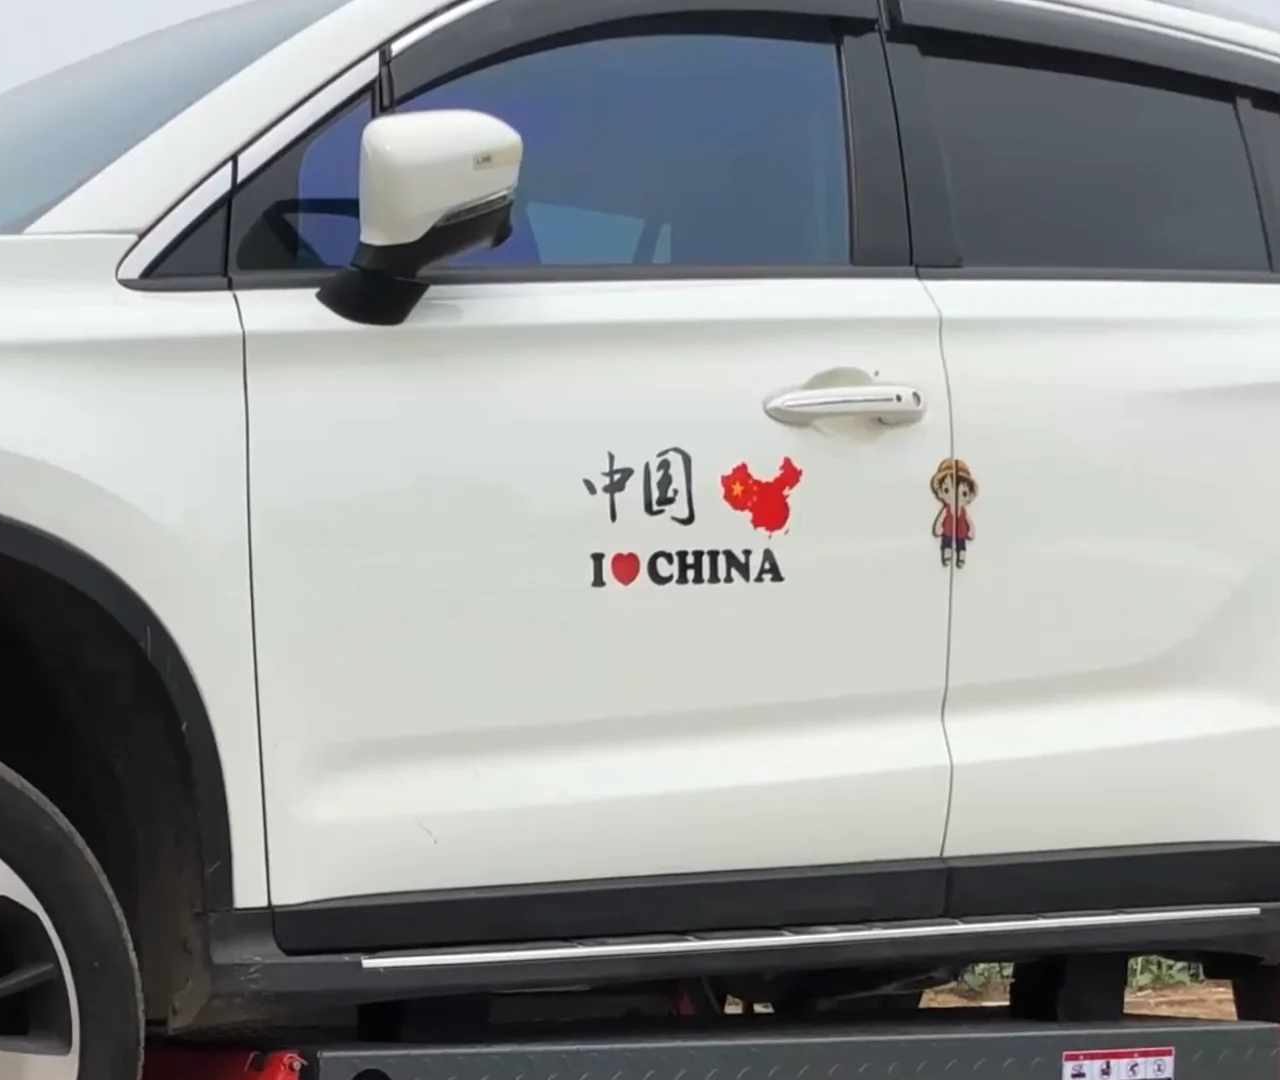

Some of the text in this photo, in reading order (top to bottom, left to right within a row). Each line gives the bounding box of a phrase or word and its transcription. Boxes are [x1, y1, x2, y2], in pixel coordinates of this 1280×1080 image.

[582, 447, 696, 526] 中国
[590, 548, 785, 588] I CHINA
